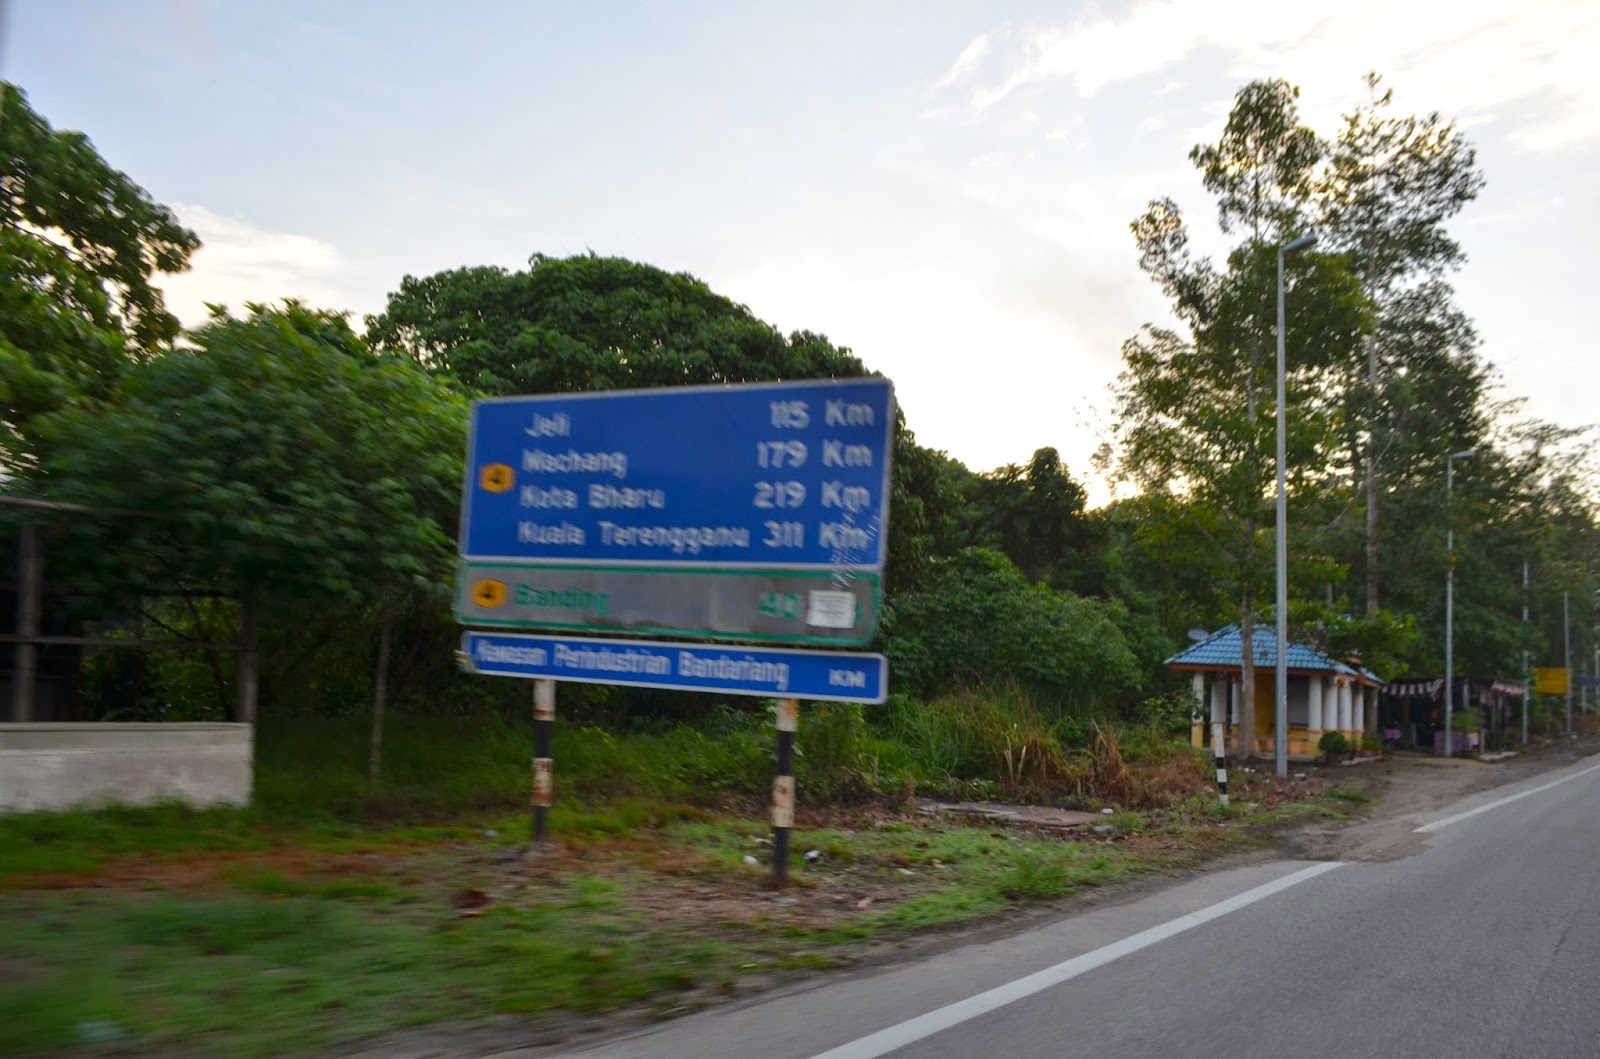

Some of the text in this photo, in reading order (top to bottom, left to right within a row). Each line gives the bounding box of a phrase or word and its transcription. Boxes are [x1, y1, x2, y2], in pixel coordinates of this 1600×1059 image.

[524, 398, 875, 438] Jeli 115 Km
[521, 439, 873, 479] Machang 179 Km
[519, 480, 872, 509] Kota Bharu 219 Km
[517, 520, 870, 555] Kuala Terengganu 311 Km
[514, 582, 610, 618] Banding
[476, 638, 548, 666] Kawasan
[553, 642, 672, 675] Perindustrian
[829, 668, 867, 689] KM
